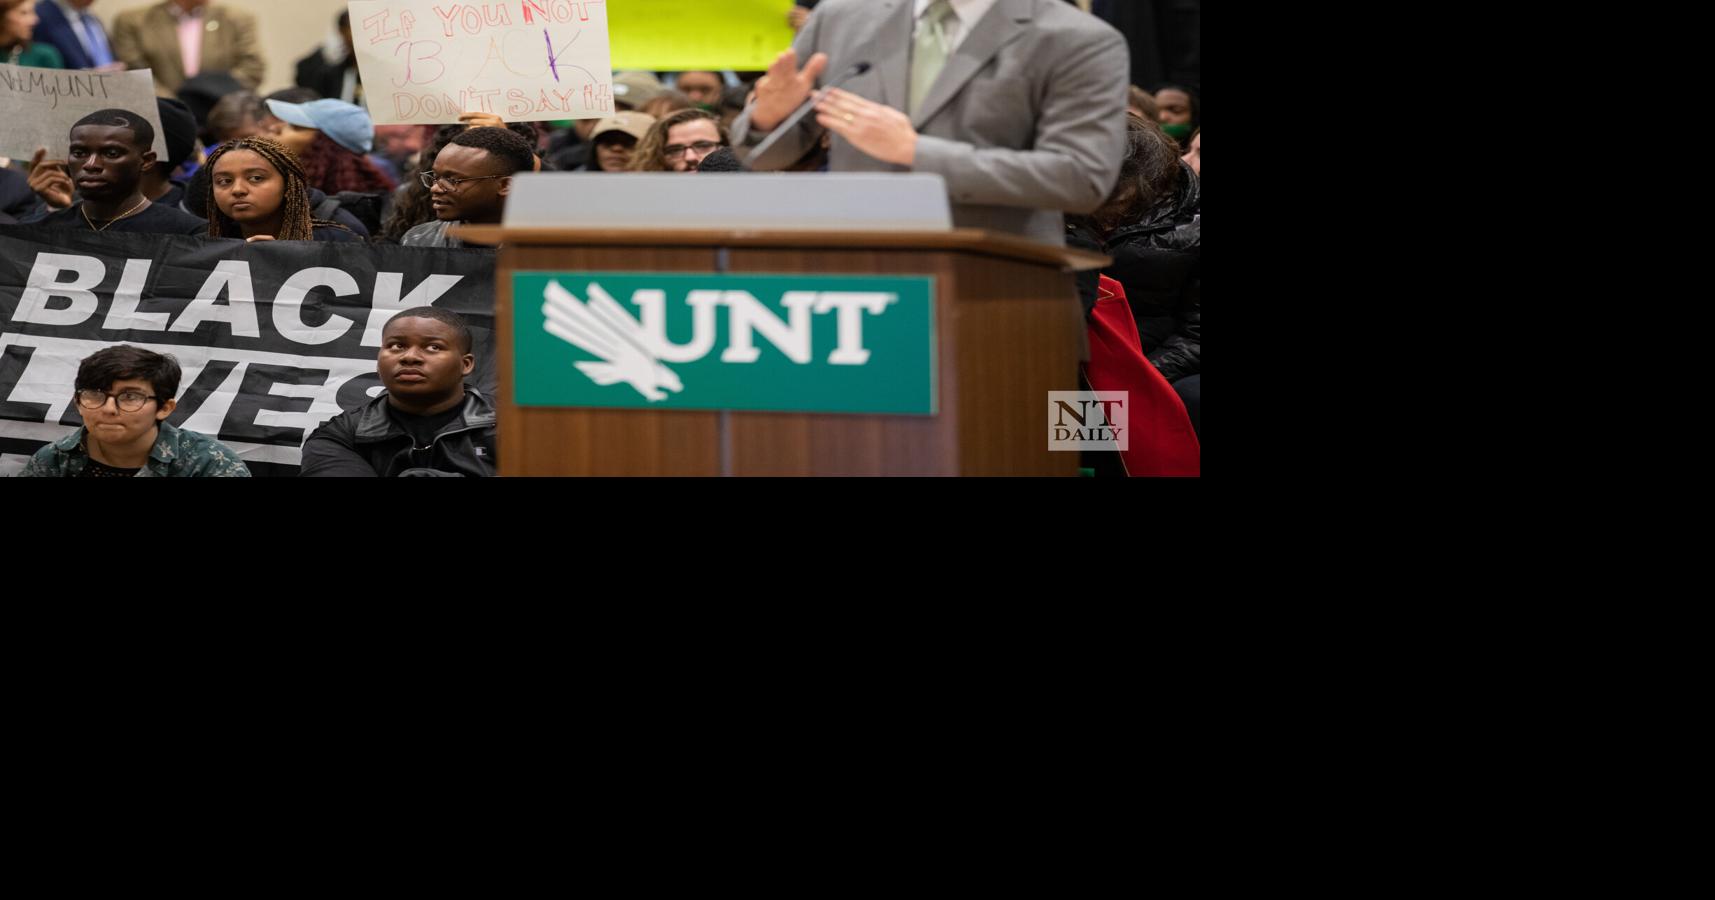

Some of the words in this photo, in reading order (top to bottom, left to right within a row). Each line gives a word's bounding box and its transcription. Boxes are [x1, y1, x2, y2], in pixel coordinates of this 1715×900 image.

[433, 3, 512, 37] YOU
[522, 0, 603, 25] NOT
[506, 87, 575, 117] SAY
[11, 252, 463, 347] BLACK
[631, 289, 898, 365] UNT
